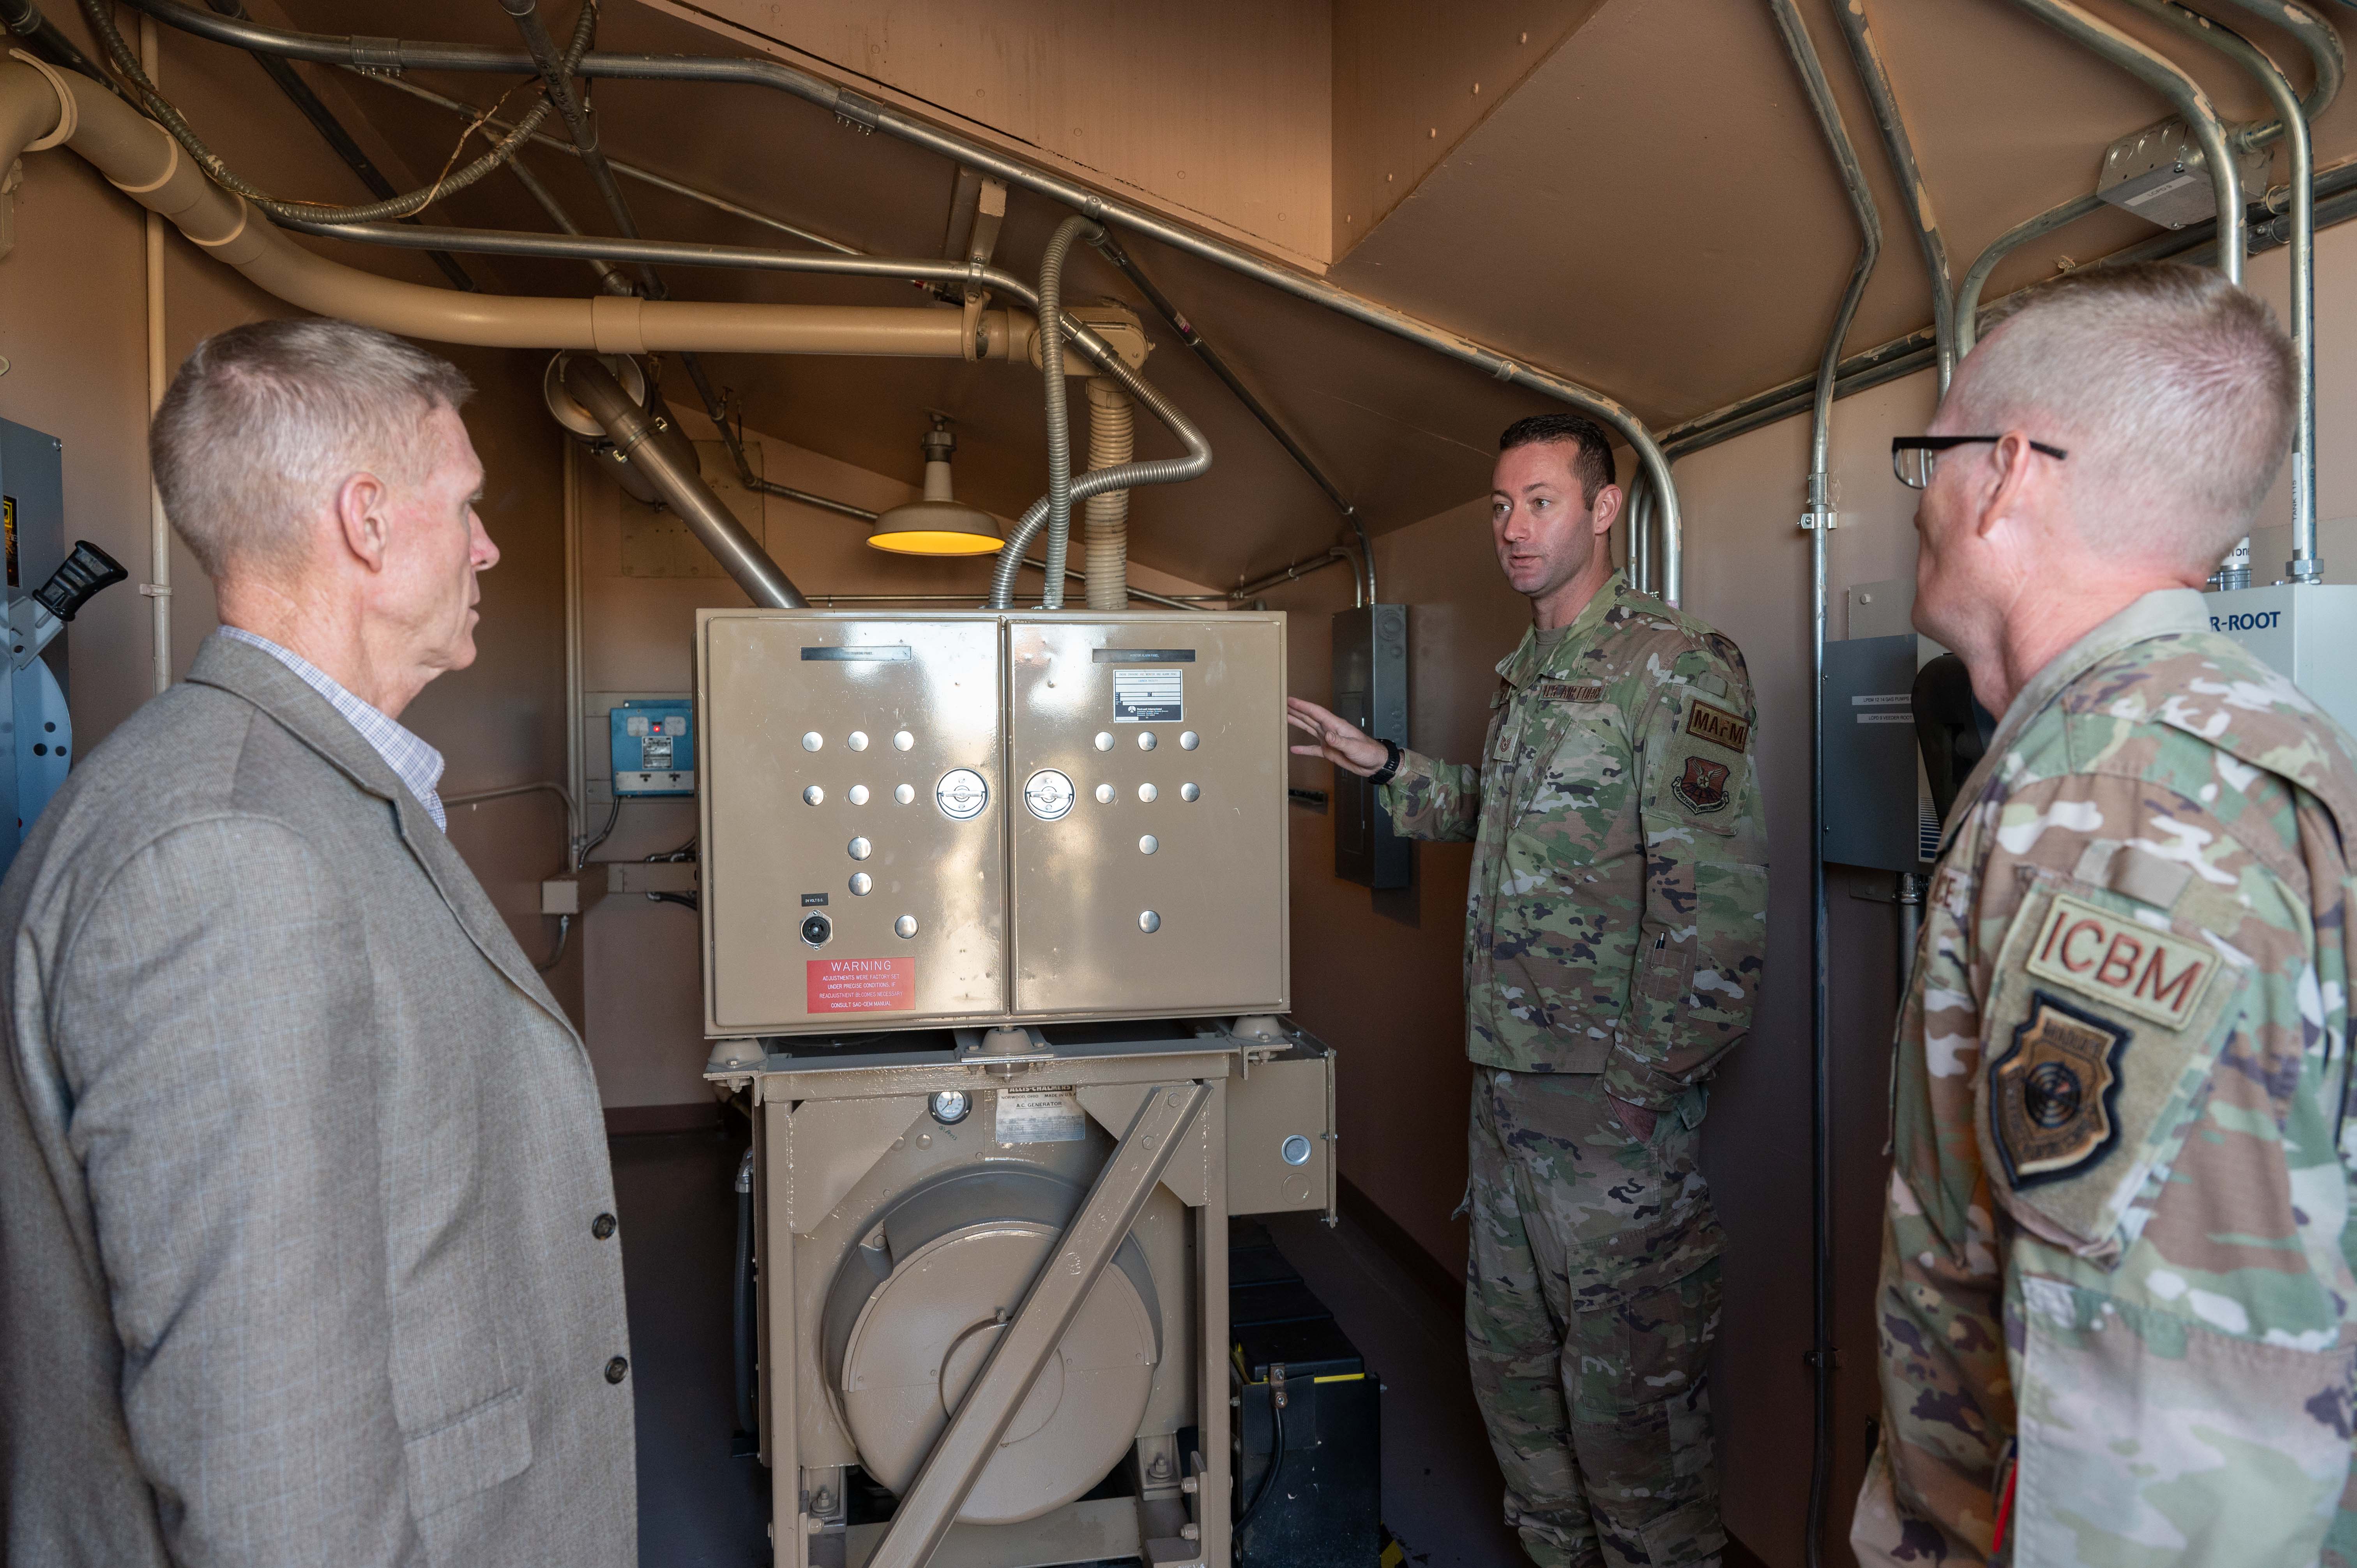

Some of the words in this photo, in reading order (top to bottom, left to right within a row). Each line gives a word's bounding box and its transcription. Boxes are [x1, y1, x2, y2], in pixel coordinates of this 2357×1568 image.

[1559, 685, 1577, 699] AIR
[1694, 709, 1744, 744] MAFM
[831, 960, 891, 971] WARNING
[2040, 911, 2204, 1013] ICBM
